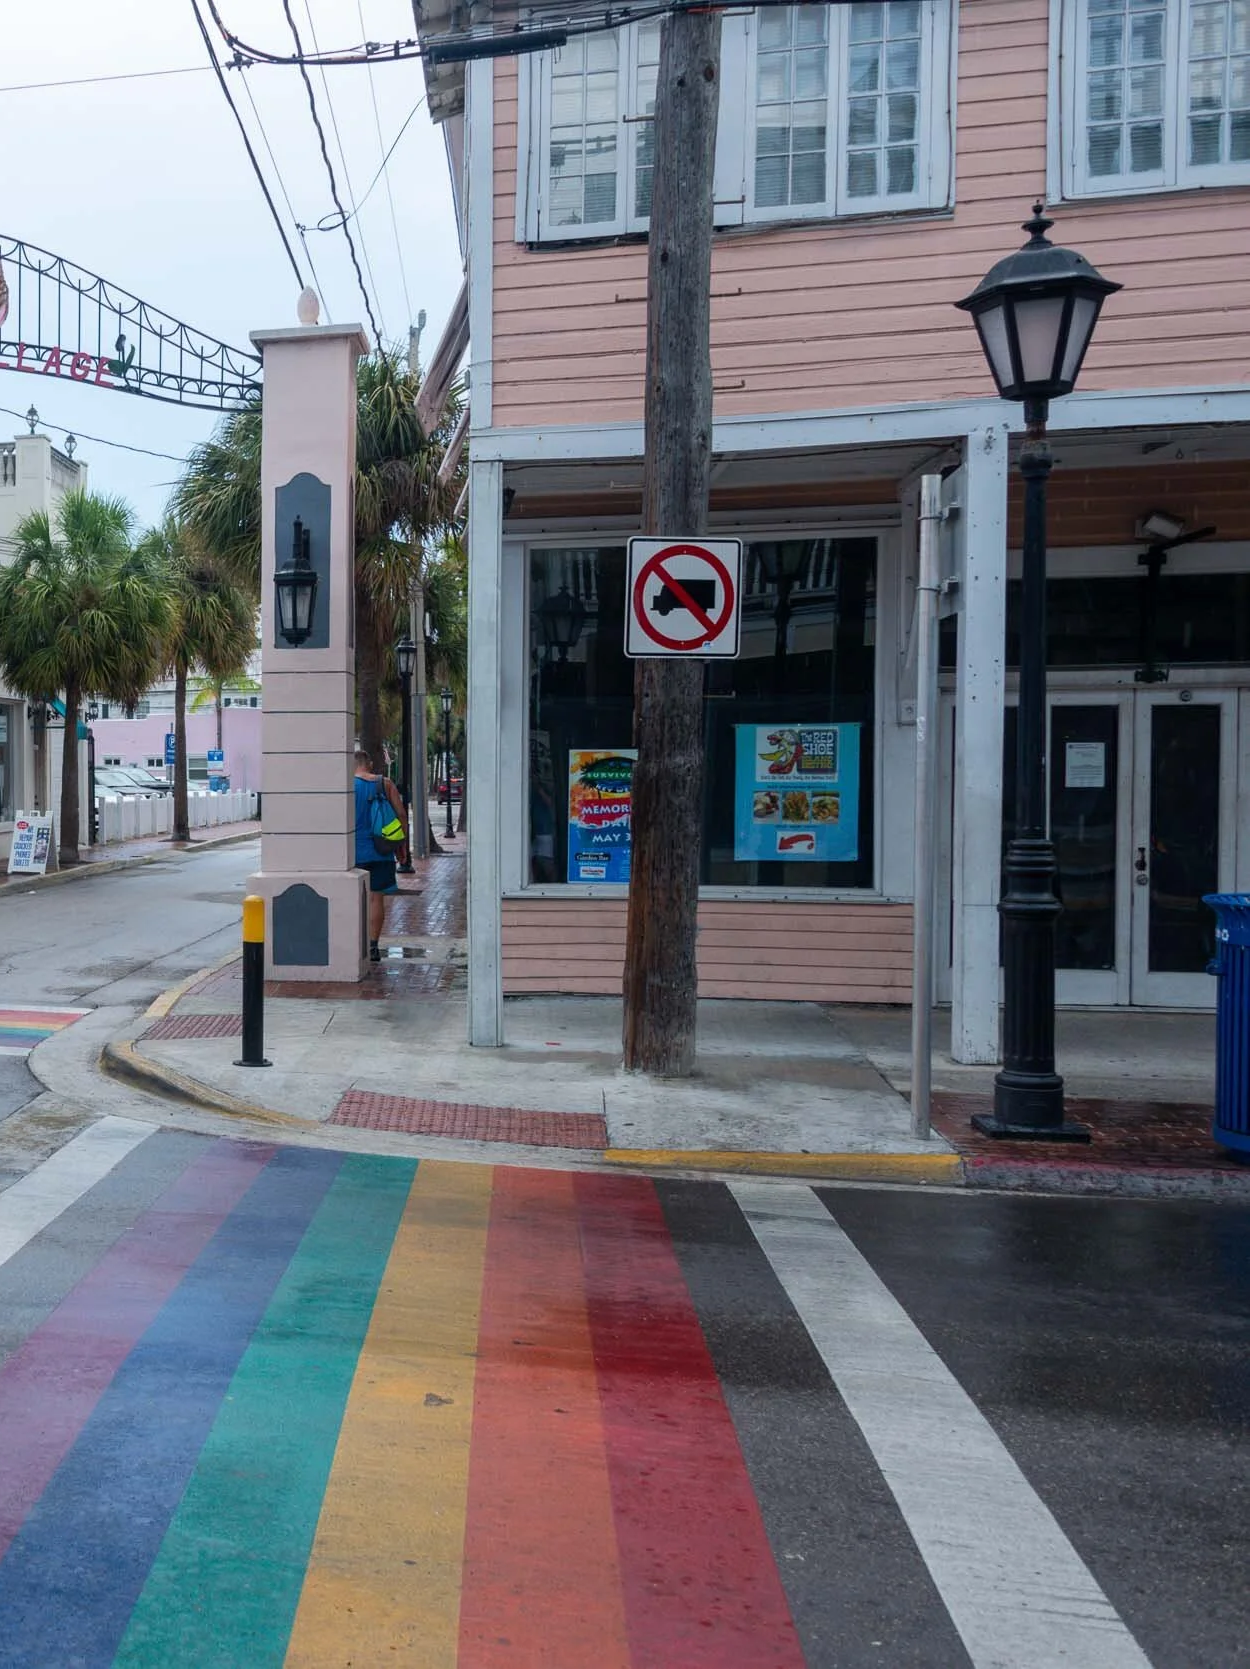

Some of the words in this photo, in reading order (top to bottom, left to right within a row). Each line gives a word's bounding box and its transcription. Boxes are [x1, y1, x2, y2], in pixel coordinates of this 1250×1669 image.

[813, 732, 834, 744] RED
[802, 743, 834, 755] SHOE
[592, 833, 621, 843] MAY
